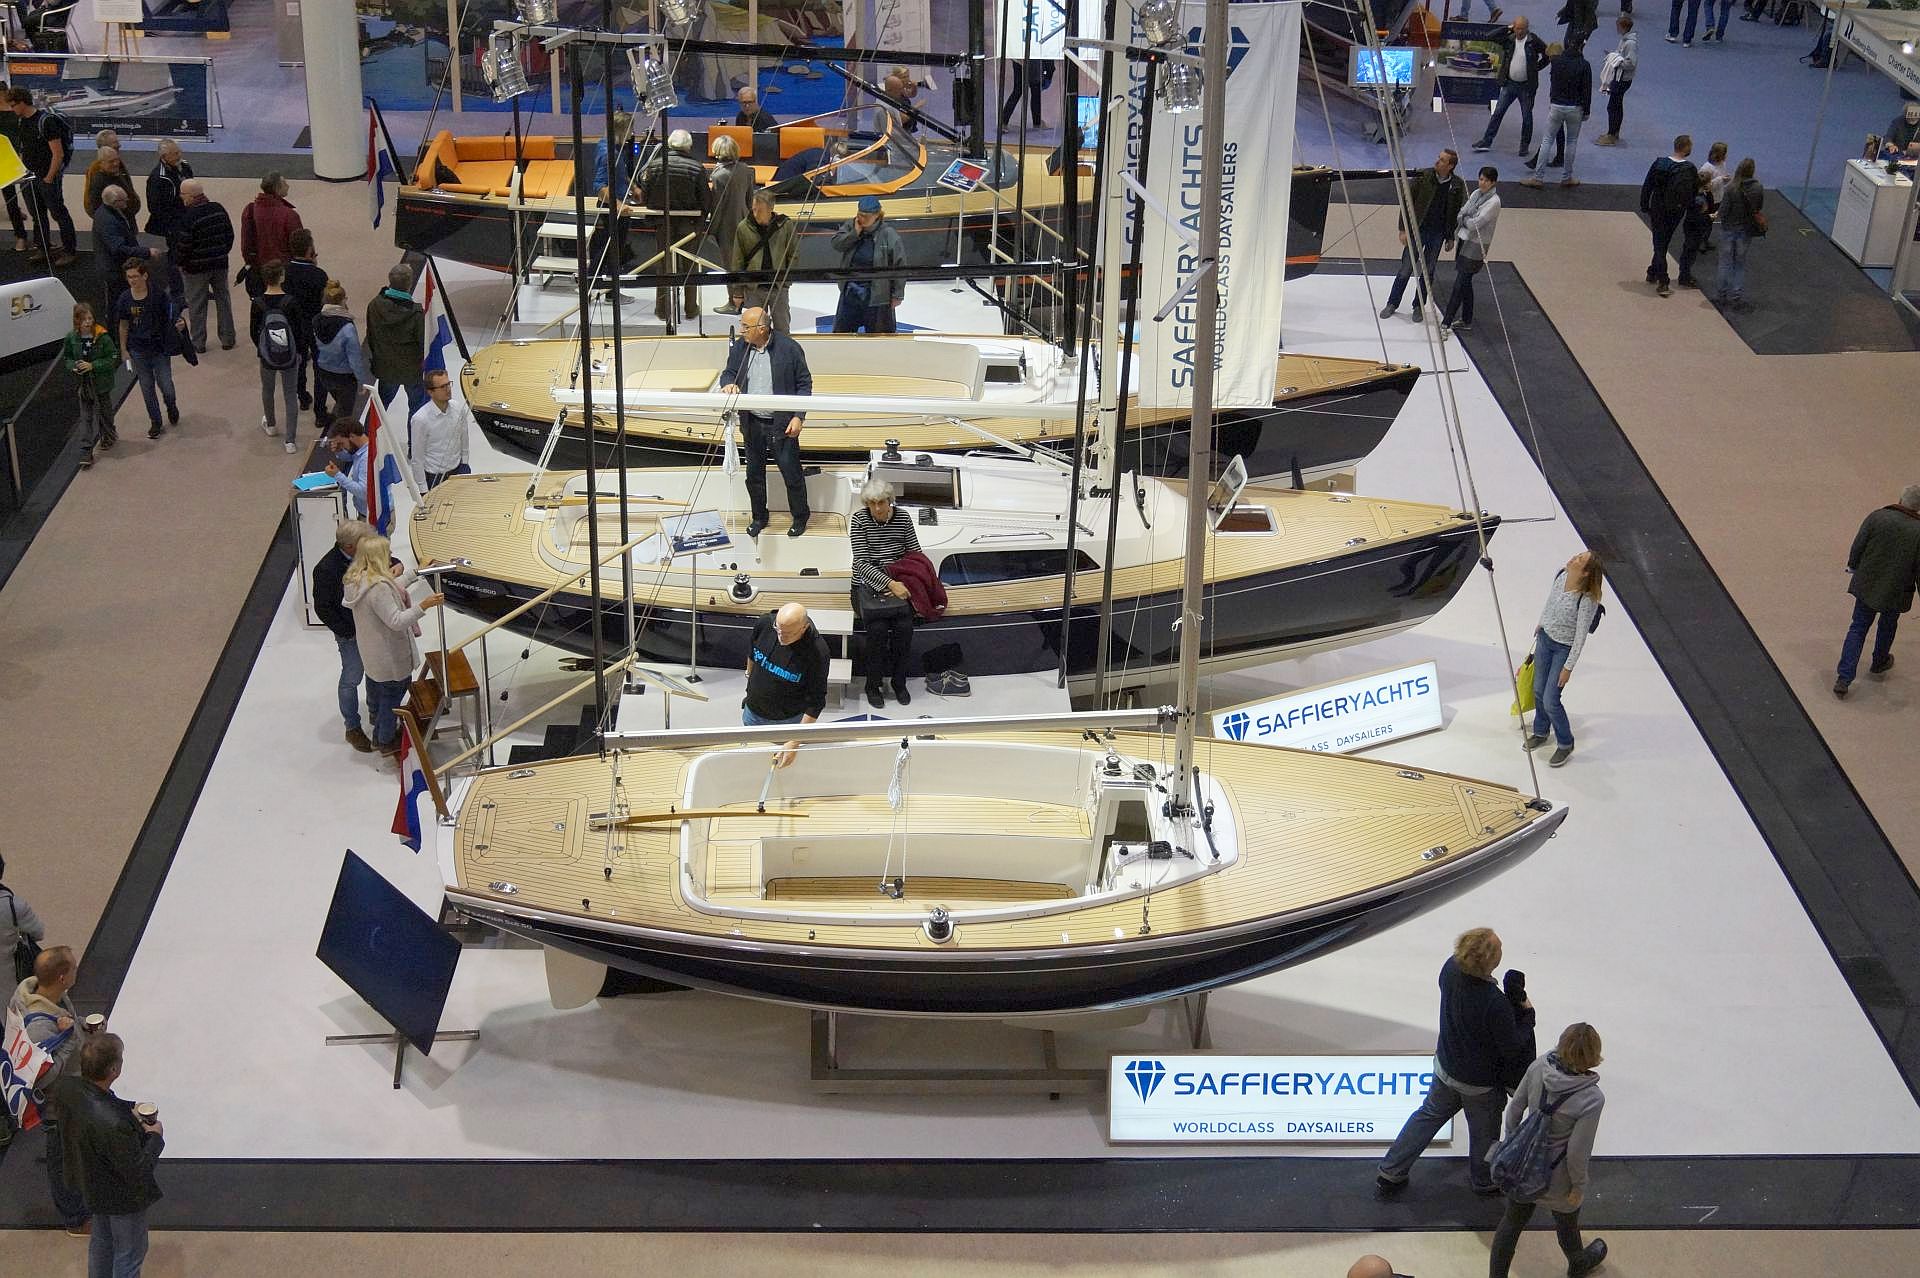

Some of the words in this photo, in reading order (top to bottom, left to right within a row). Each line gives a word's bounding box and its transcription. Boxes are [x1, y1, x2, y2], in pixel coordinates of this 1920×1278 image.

[1218, 141, 1238, 249] DAYSAILERS
[1256, 676, 1430, 736] SAFFIERYACHTS
[1336, 724, 1393, 747] DAYSAILERS
[1173, 1072, 1433, 1095] SAFFIERYACHTS
[1173, 1121, 1275, 1134] WORLDCLASS
[1287, 1121, 1375, 1134] DAYSAILERS
